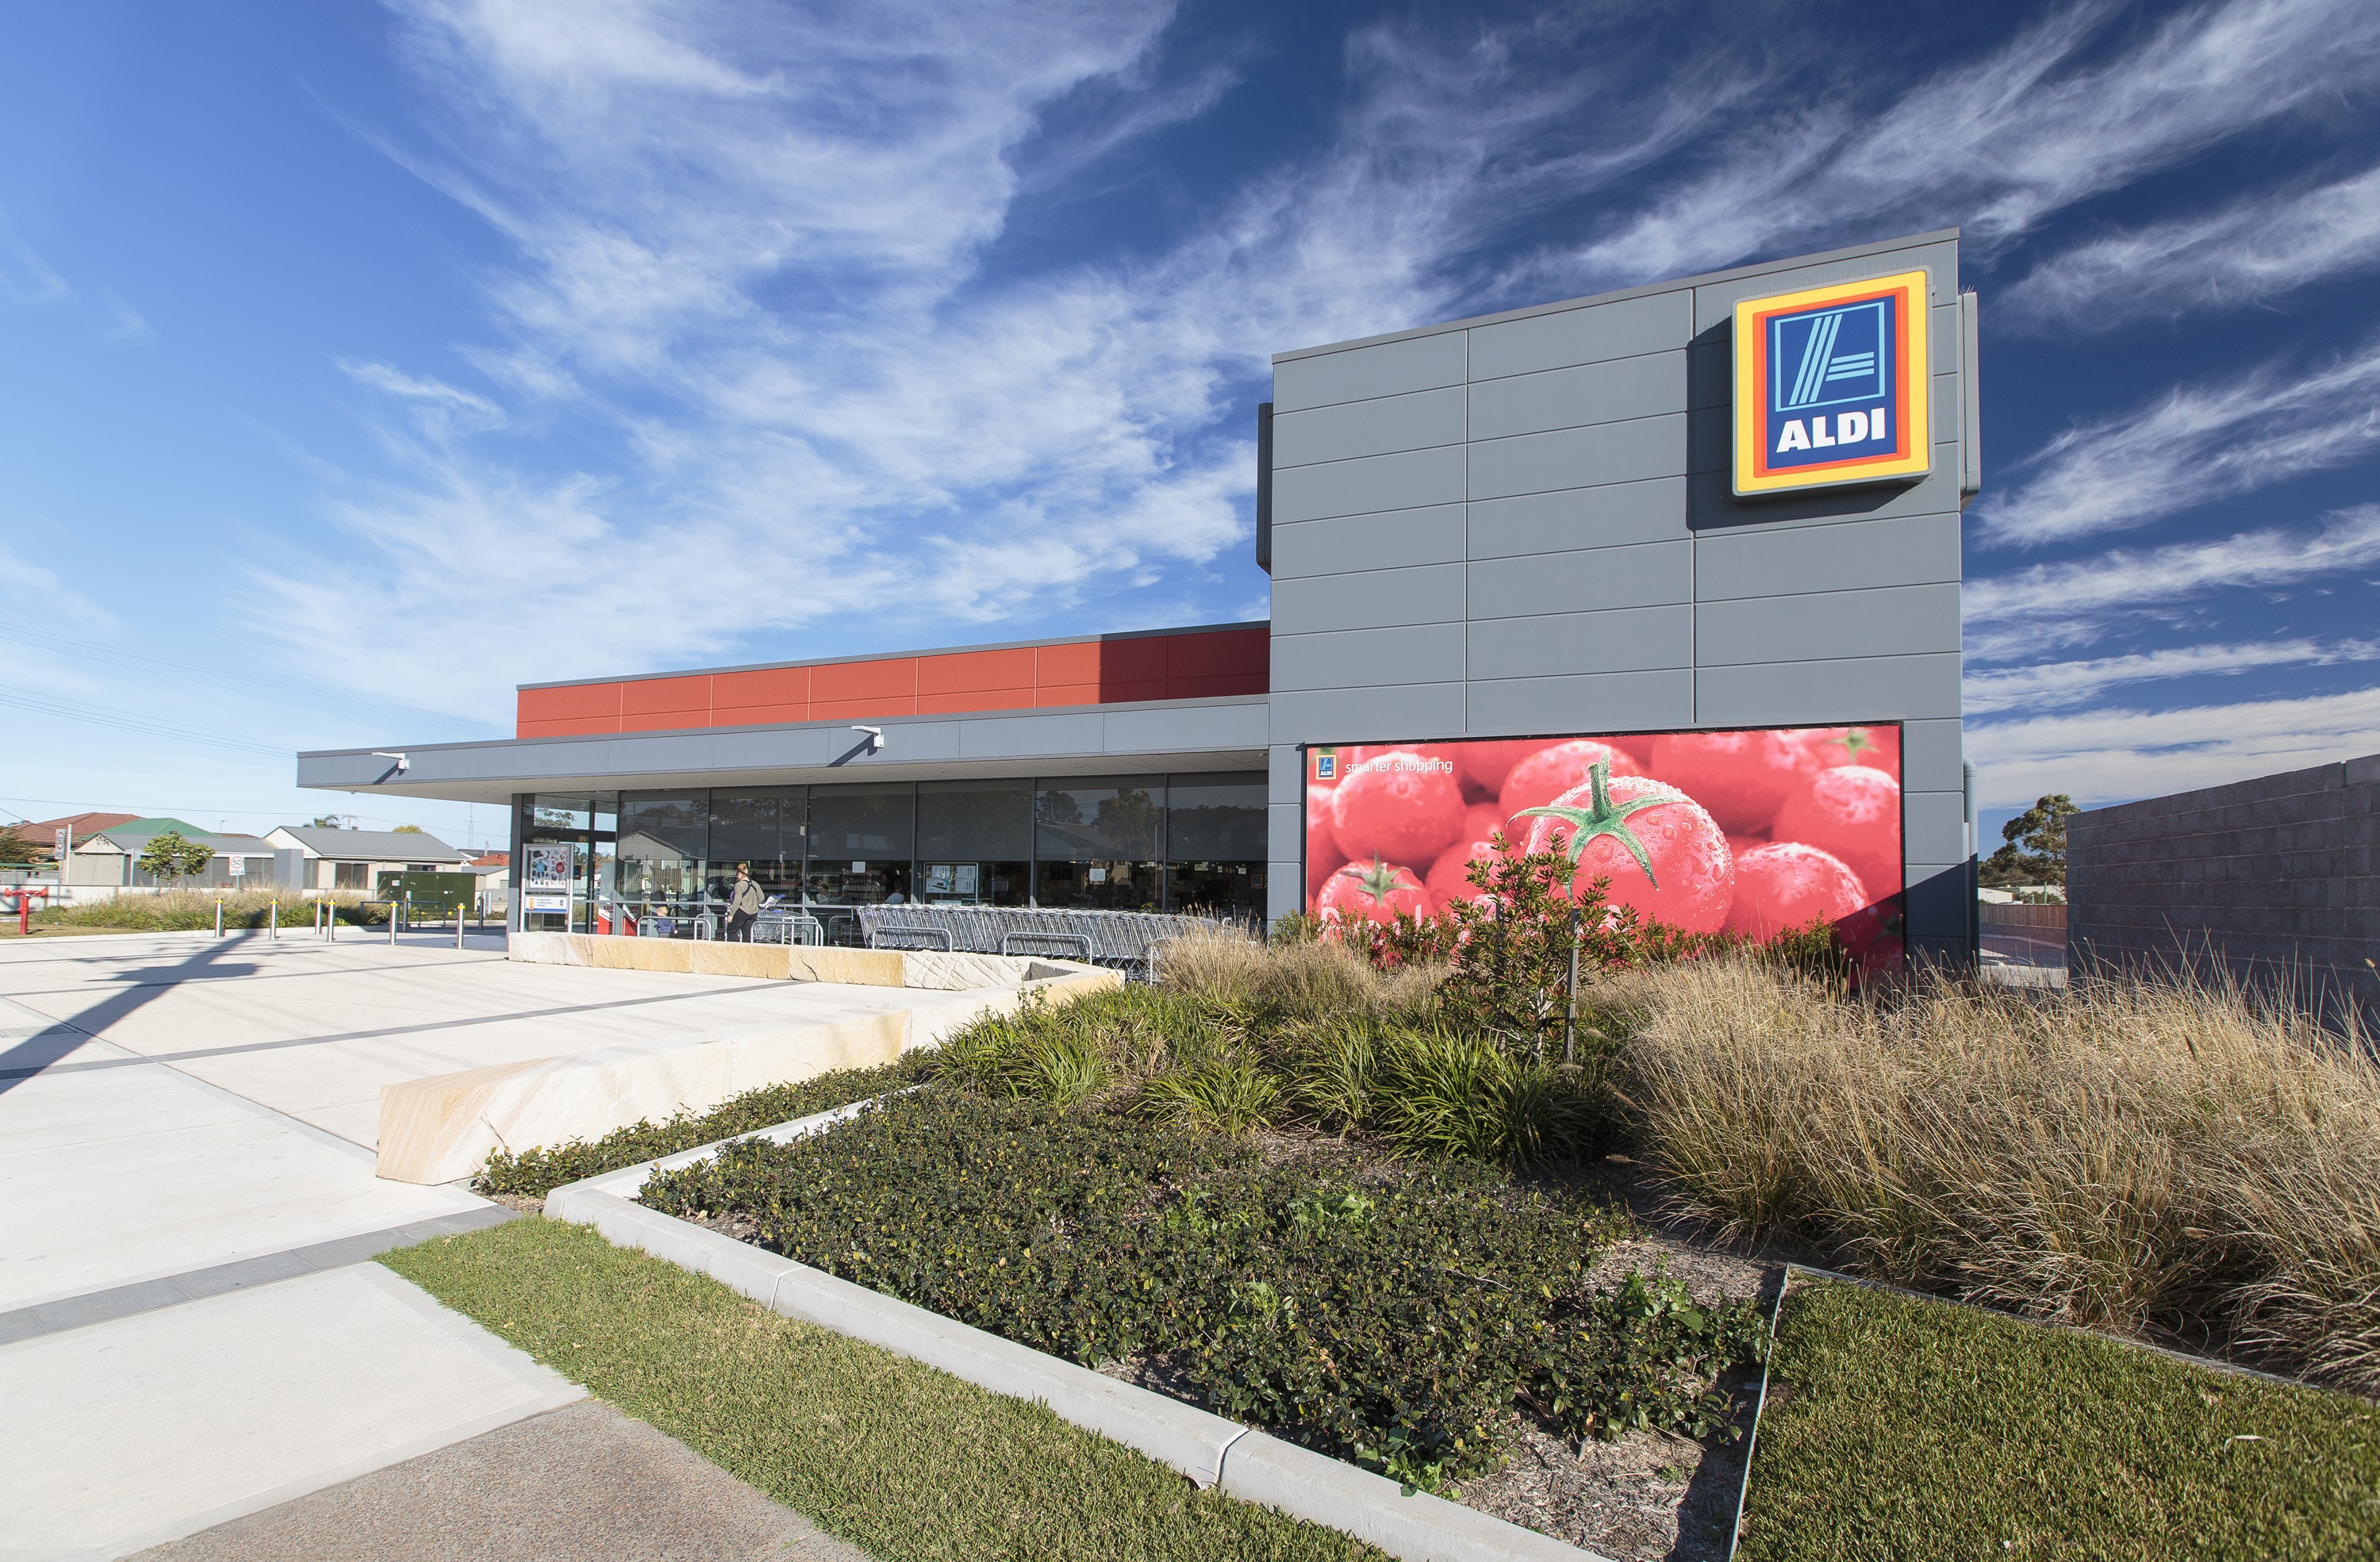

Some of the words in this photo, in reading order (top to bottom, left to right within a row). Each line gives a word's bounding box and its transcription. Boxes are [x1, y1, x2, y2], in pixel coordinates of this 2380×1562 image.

[1775, 407, 1886, 453] ALDI
[1345, 762, 1392, 773] smarter
[1394, 760, 1453, 774] shopping
